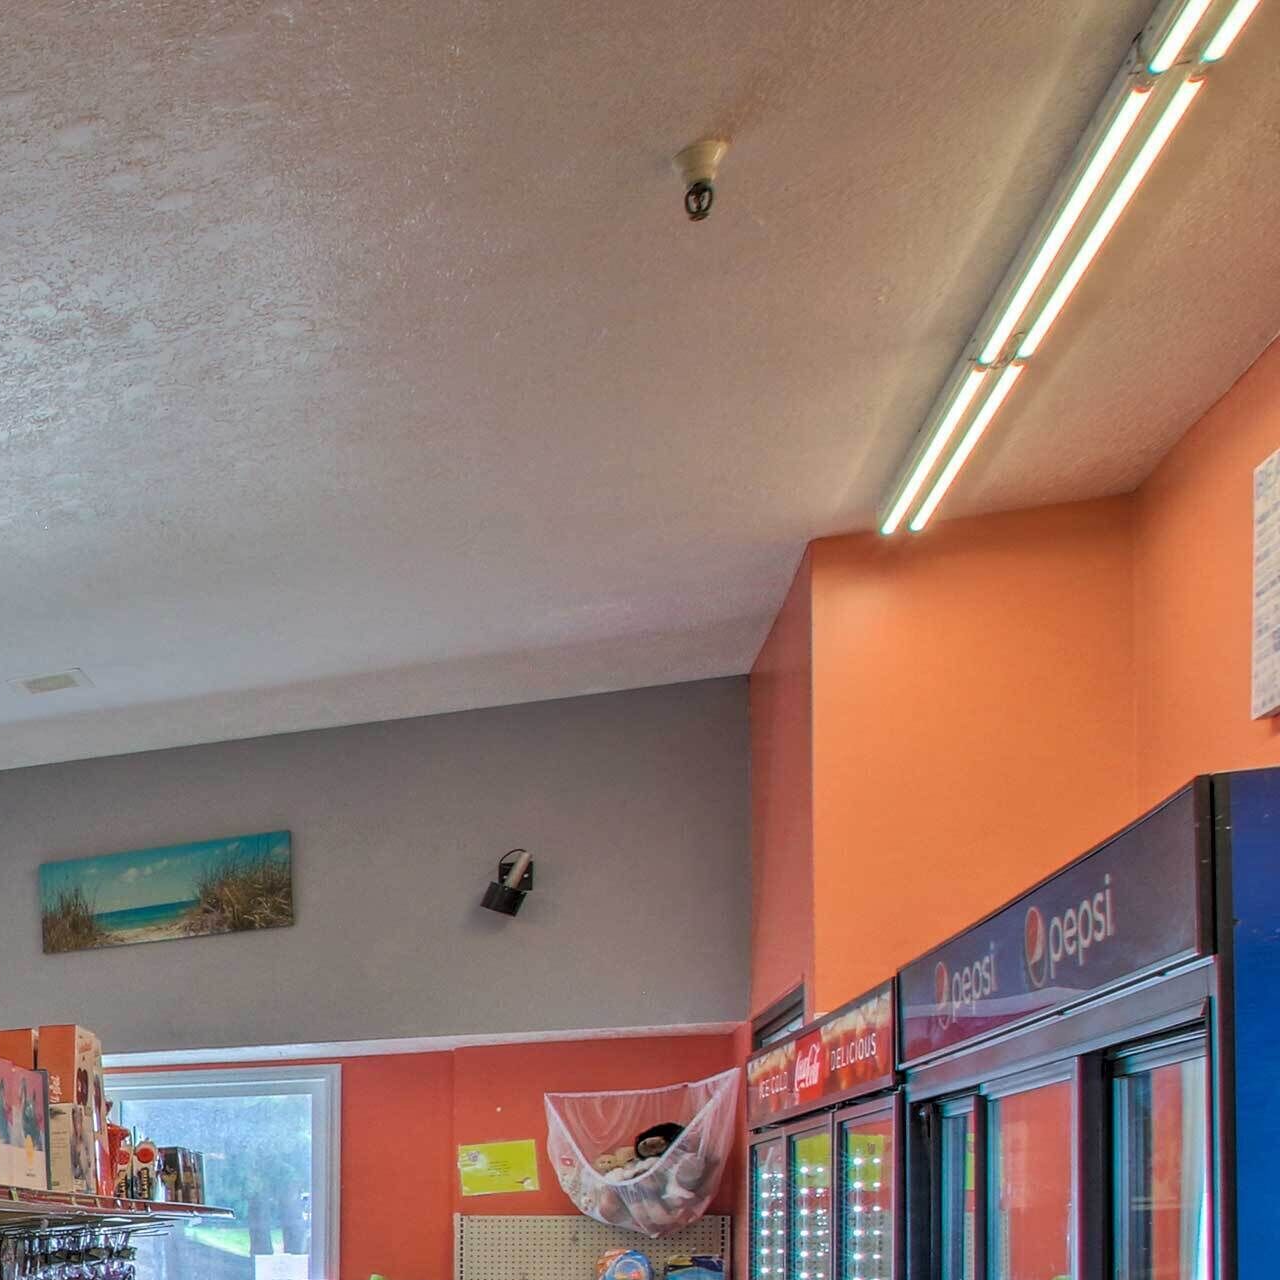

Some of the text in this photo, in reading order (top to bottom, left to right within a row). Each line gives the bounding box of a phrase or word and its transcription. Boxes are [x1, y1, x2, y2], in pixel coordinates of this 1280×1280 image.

[1048, 873, 1115, 980] pepsi
[951, 943, 997, 1022] pepsi
[770, 1072, 788, 1094] COLD
[830, 1033, 877, 1071] DELICIOUS
